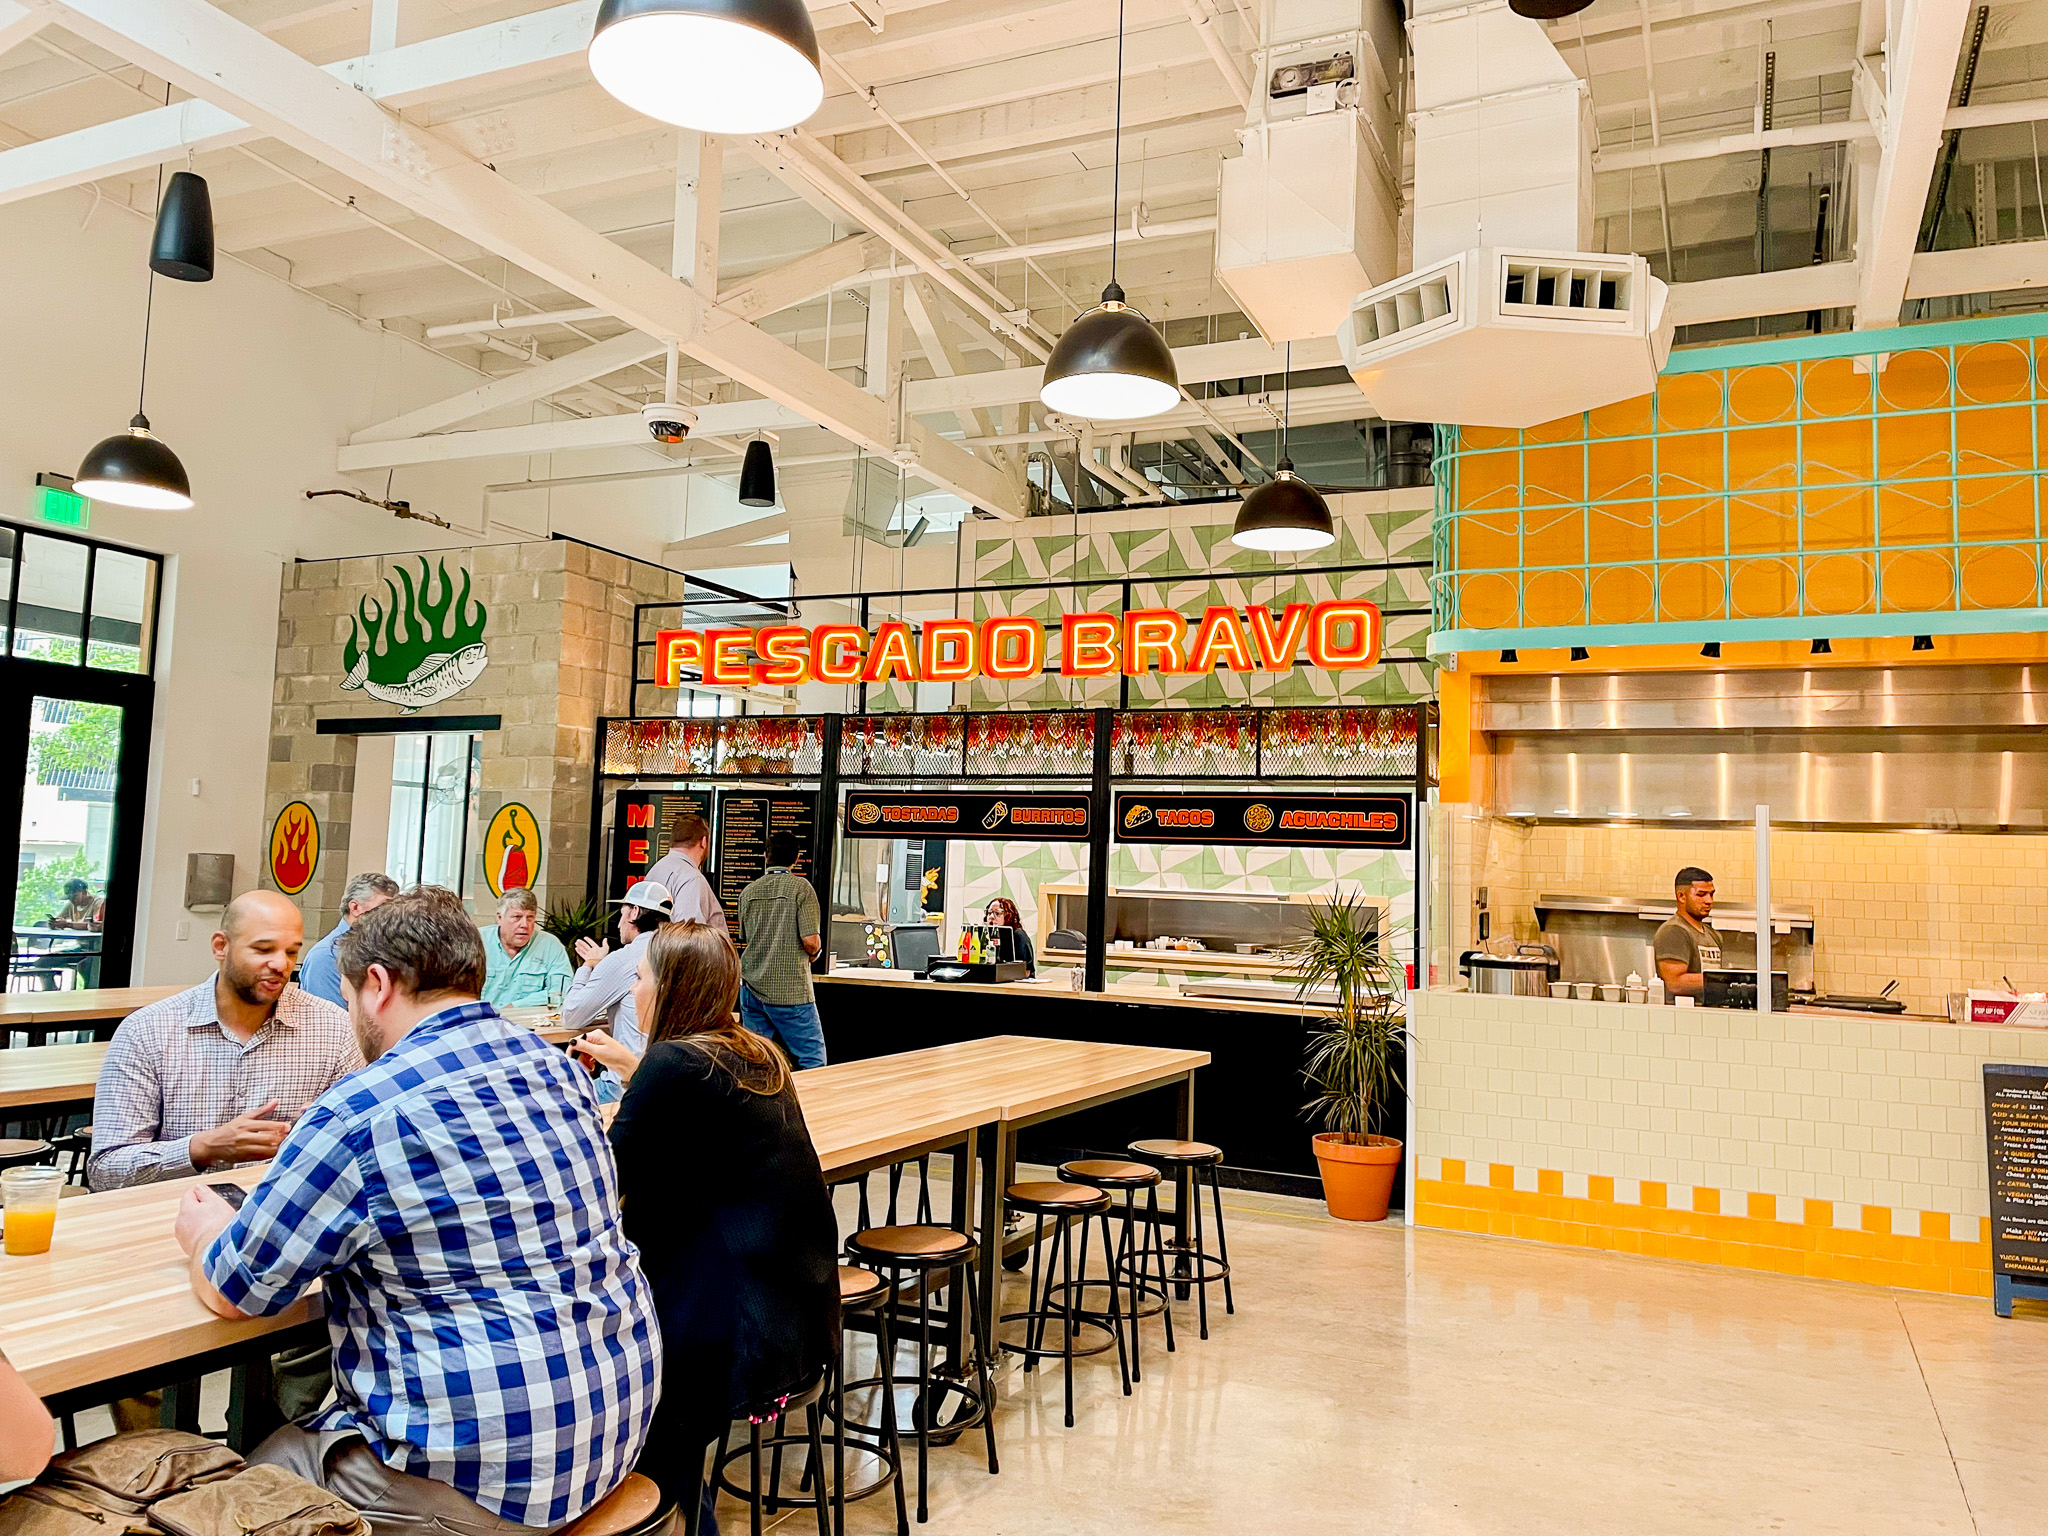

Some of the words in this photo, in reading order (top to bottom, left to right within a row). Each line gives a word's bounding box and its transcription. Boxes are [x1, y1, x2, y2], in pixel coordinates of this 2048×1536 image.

[655, 616, 1045, 688] PESCADO
[1061, 599, 1382, 677] BRAVO
[881, 805, 959, 823] TOSTADAS
[1011, 808, 1087, 825] BURRITOS
[1155, 809, 1214, 827] TACOS
[1279, 810, 1398, 831] AGUACHILES
[2004, 1263, 2044, 1272] EMPANADAS
